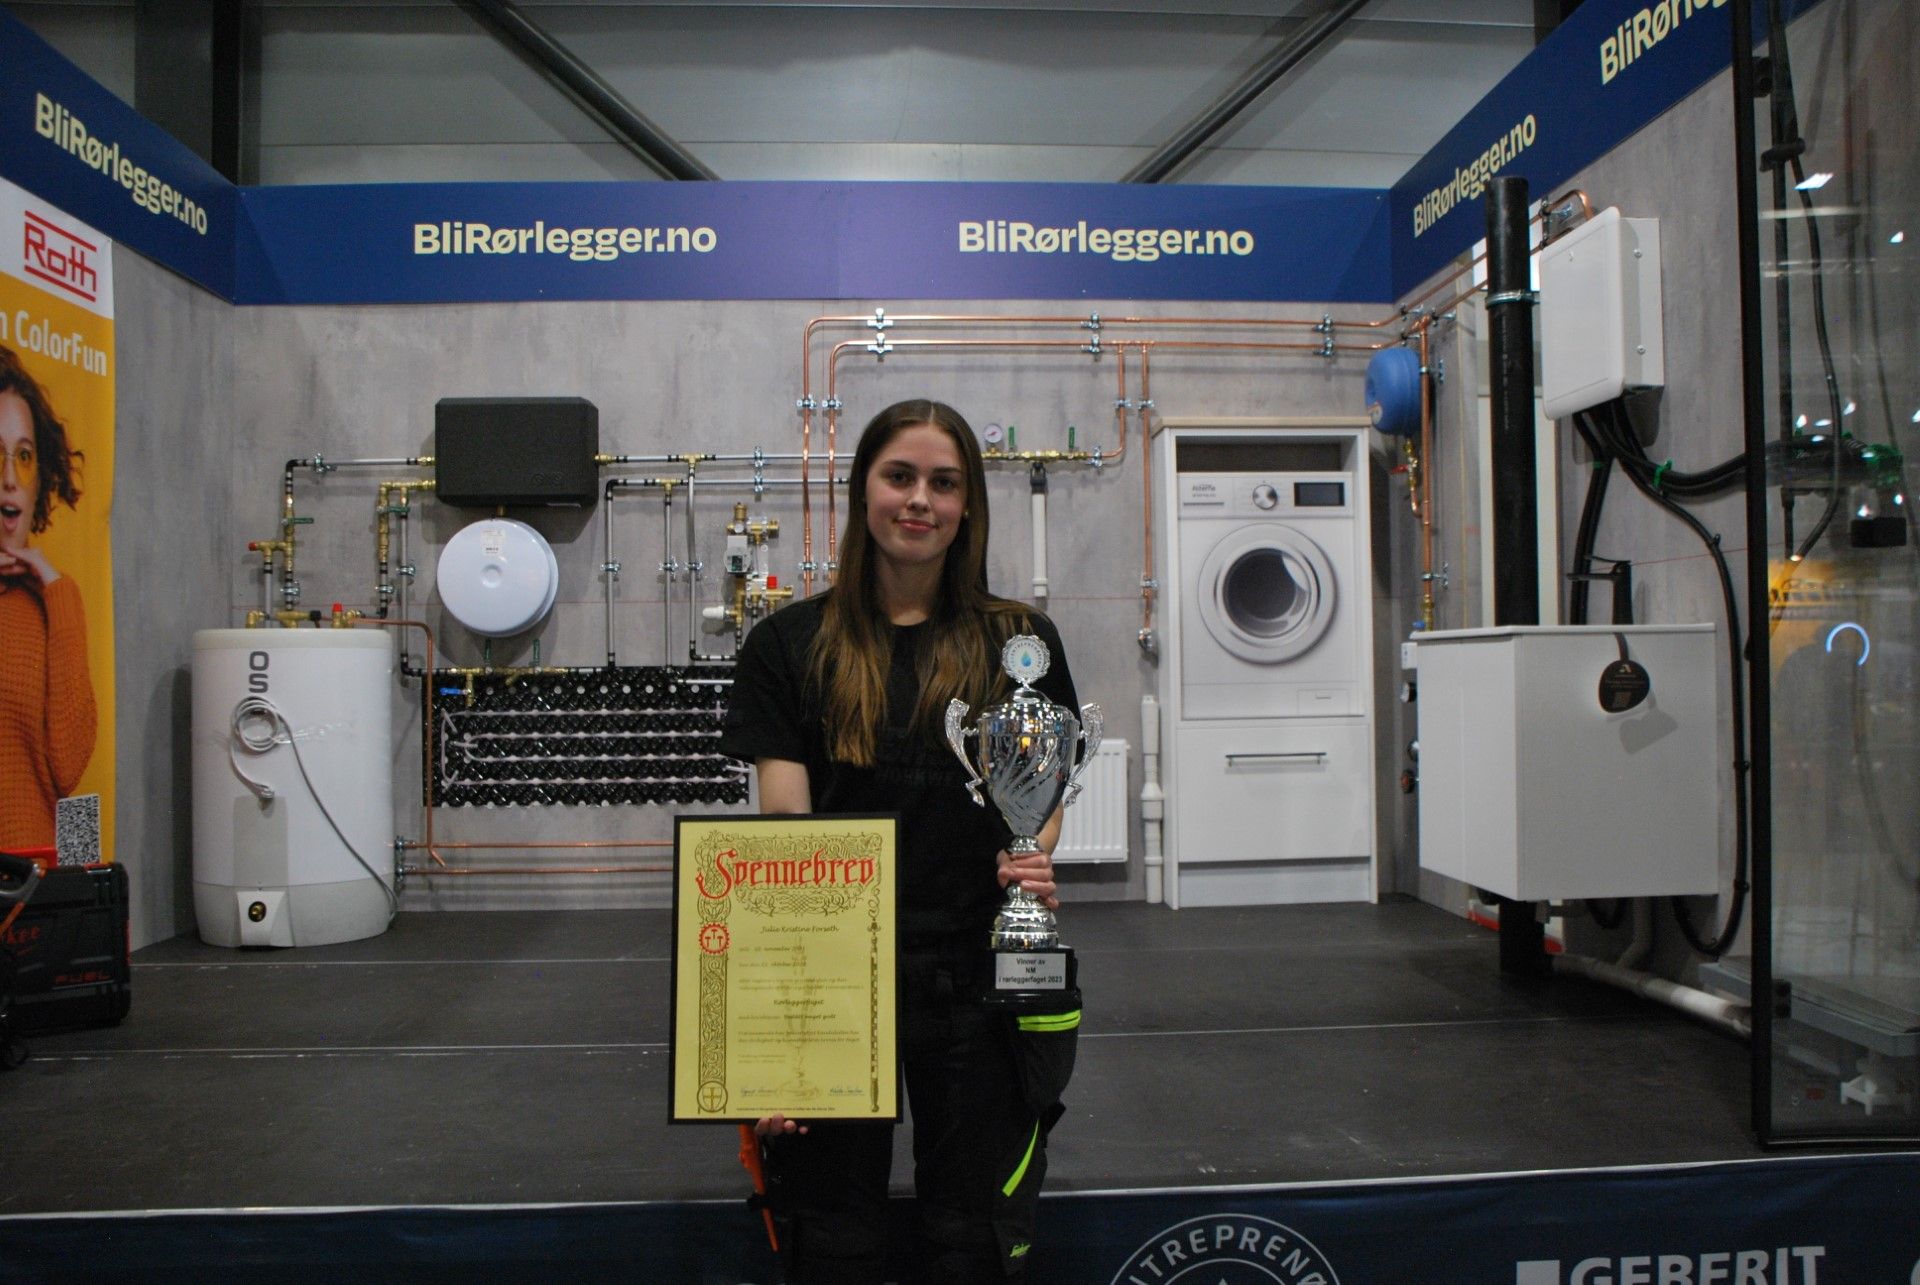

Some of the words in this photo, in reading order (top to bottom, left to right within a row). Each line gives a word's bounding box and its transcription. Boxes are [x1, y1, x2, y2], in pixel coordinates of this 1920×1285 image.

[1600, 0, 1728, 85] BliRør
[36, 92, 208, 235] BliRørlegger.no
[1413, 113, 1537, 238] BliRørlegger.no
[24, 221, 97, 292] Roth
[414, 221, 717, 262] BliRørlegger.no
[958, 220, 1255, 262] BliRørlegger.no
[15, 309, 107, 377] ColorFun
[695, 848, 875, 899] Svennebrev
[1016, 957, 1037, 965] Vinner
[1025, 966, 1037, 974] NM
[1047, 975, 1063, 983] 2023
[1569, 1245, 1826, 1285] GEBERIT
